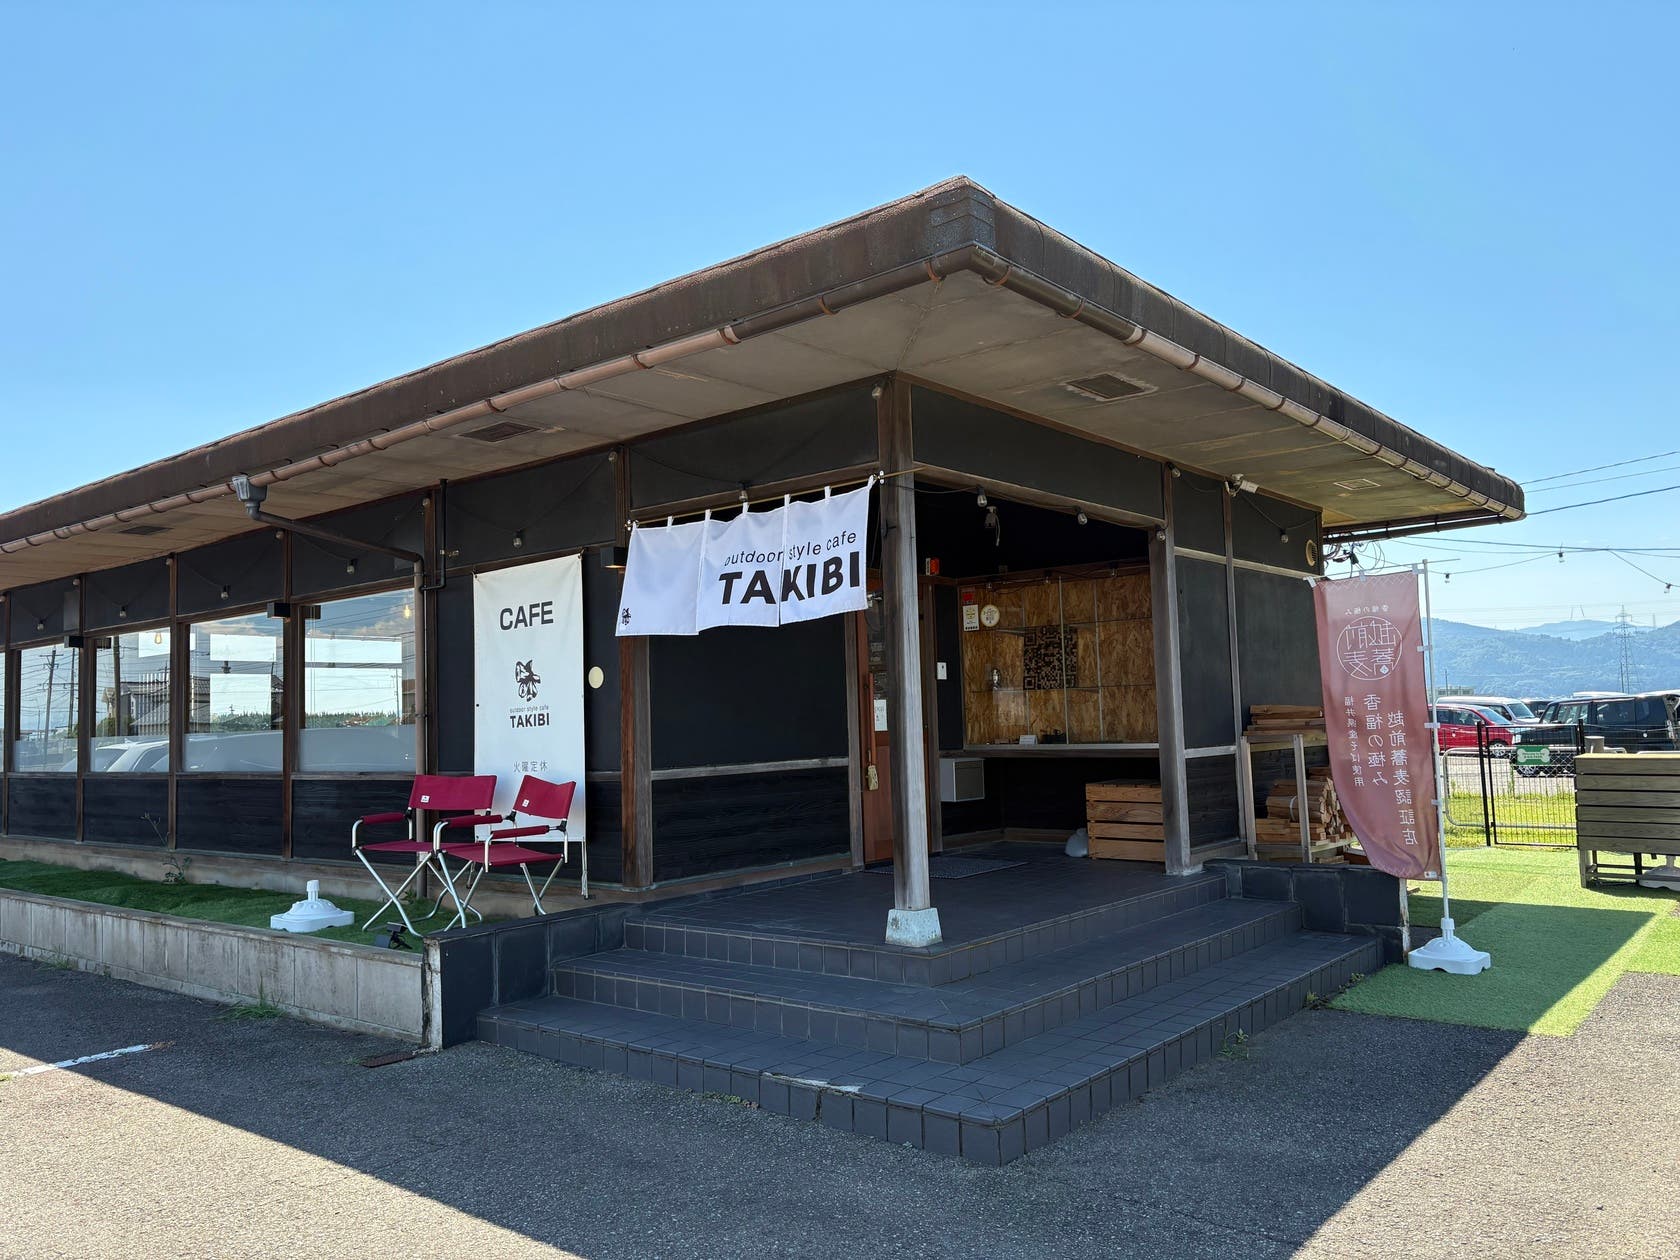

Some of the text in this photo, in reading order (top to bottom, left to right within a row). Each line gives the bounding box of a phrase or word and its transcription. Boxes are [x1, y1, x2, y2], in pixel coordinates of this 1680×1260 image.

[724, 530, 857, 567] outdoor style cafe
[718, 551, 860, 605] TAKIBI
[499, 600, 554, 631] CAFE
[527, 704, 539, 713] style
[539, 703, 550, 711] cafe
[510, 712, 550, 729] TAKIBI
[513, 760, 549, 773] 火曜定休
